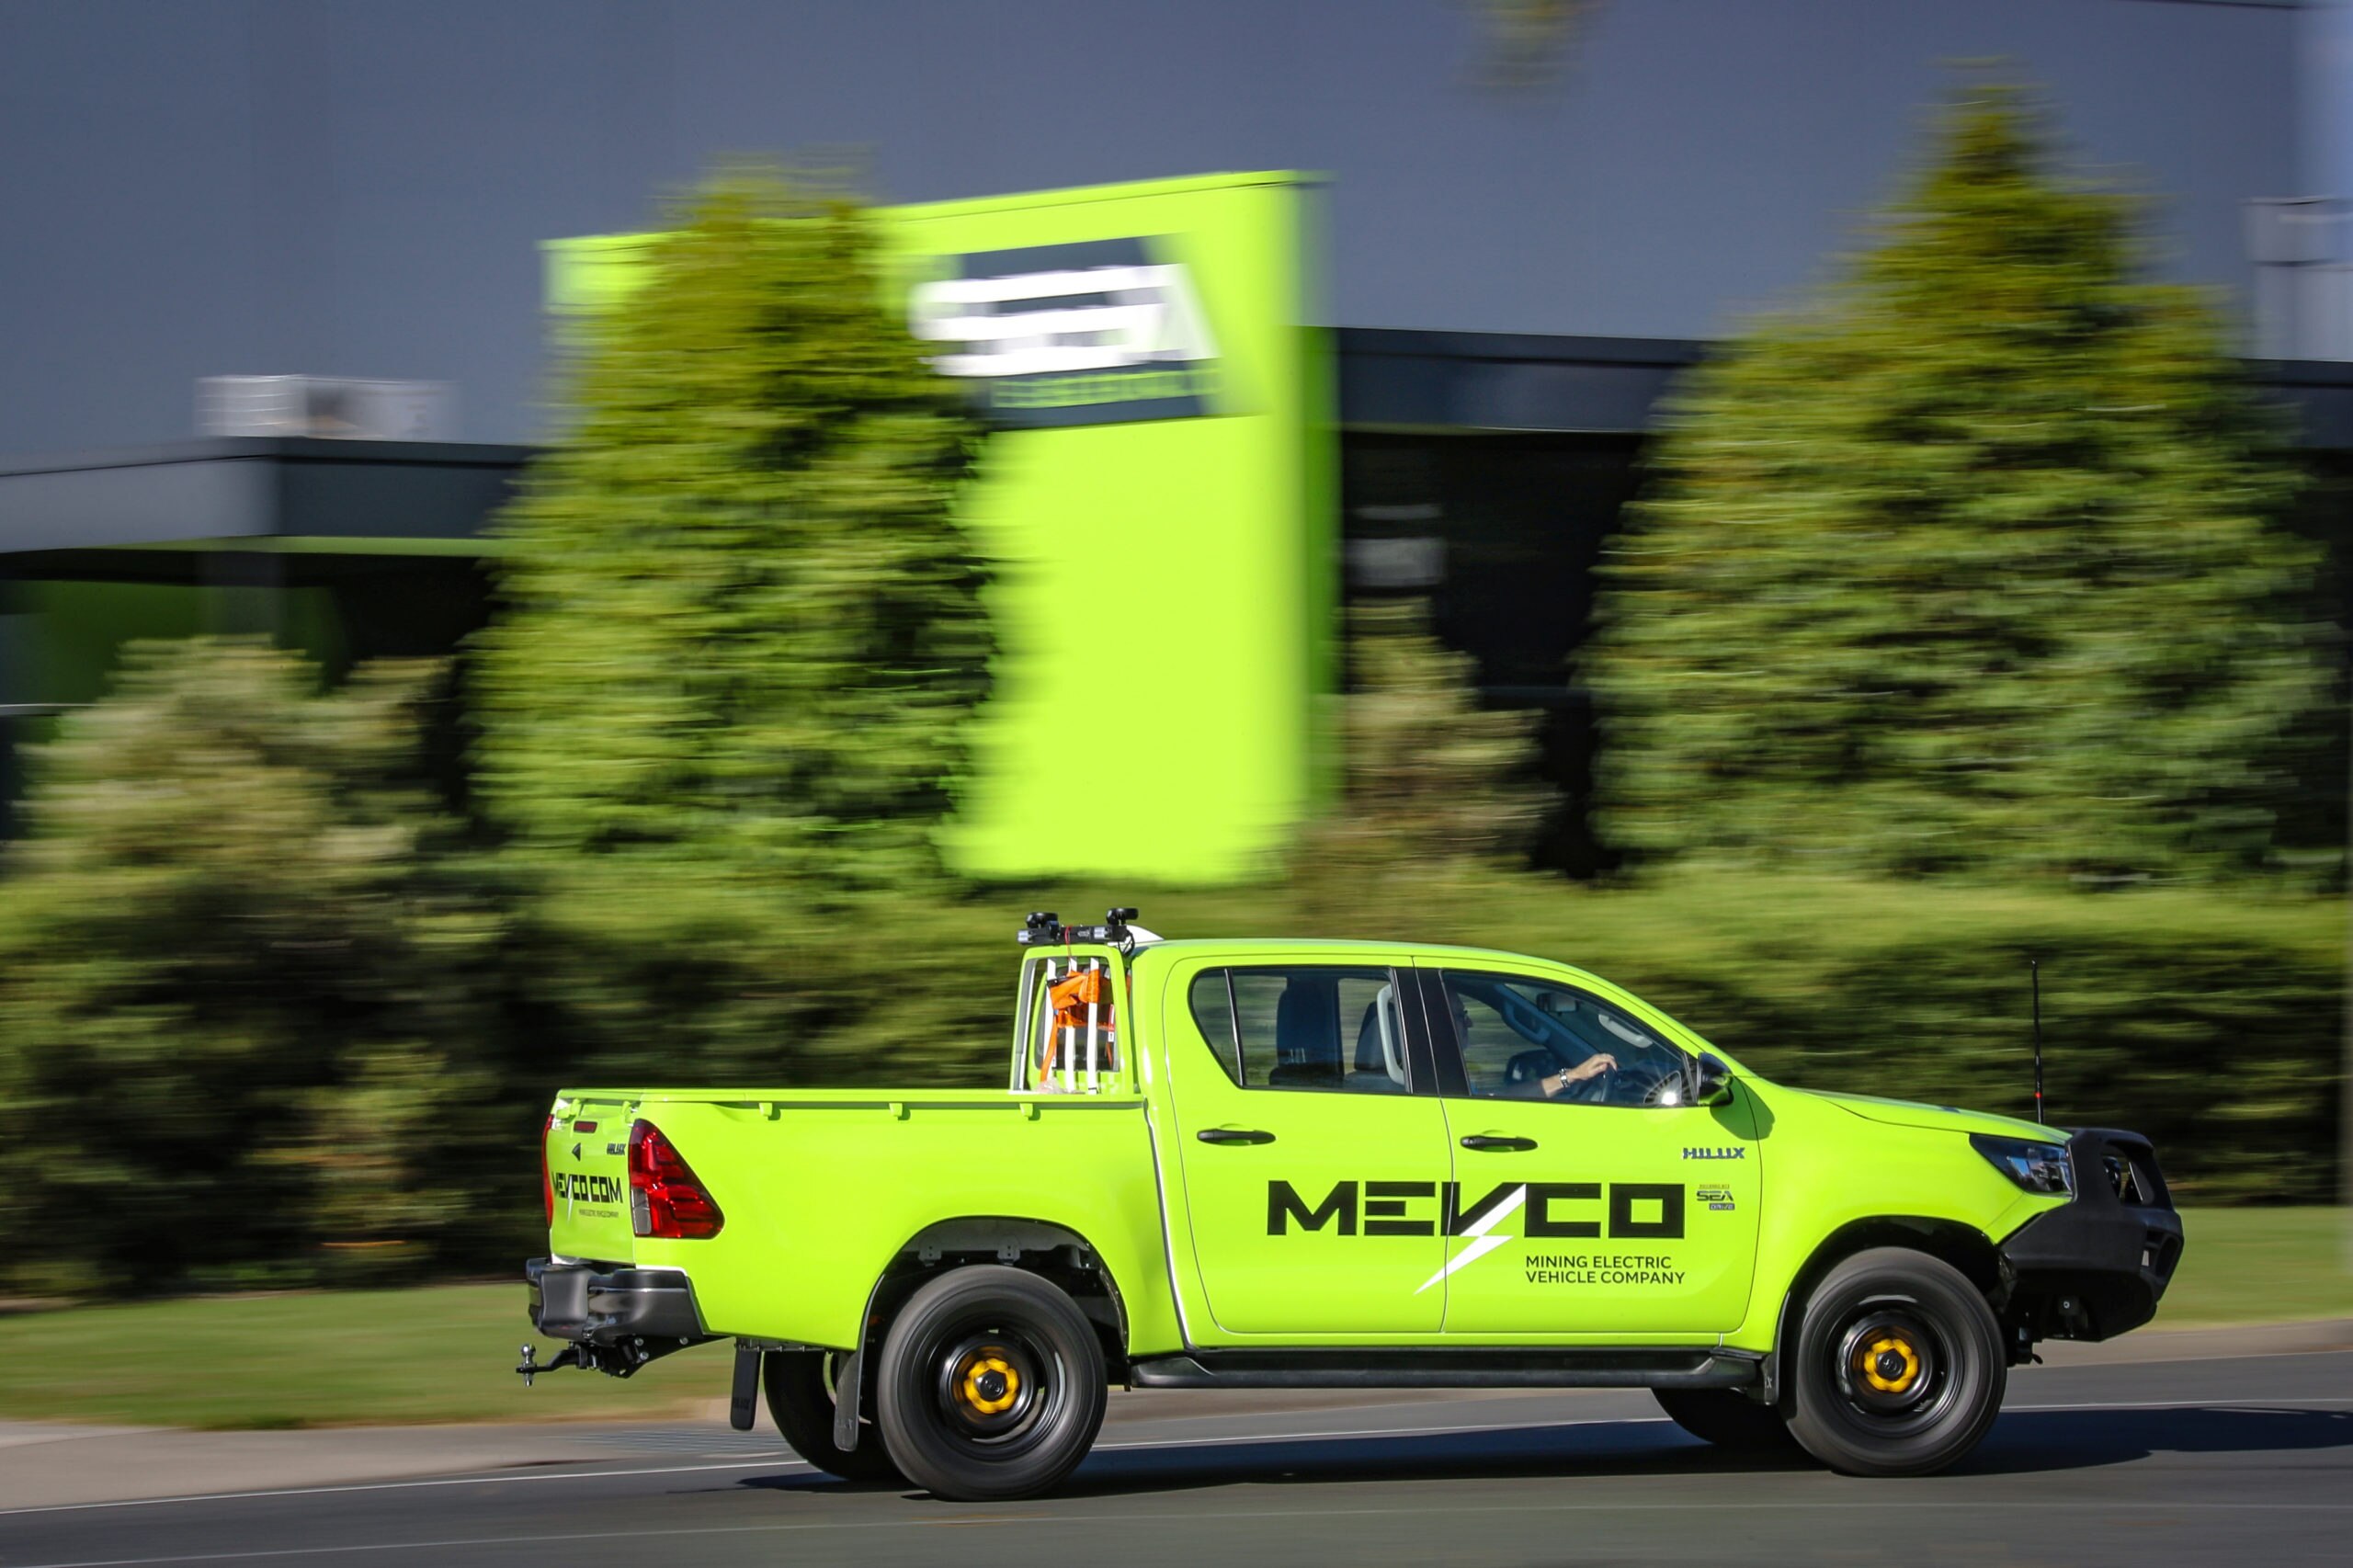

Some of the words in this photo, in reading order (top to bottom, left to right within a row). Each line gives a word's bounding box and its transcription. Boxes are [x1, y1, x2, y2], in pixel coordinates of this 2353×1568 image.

[1682, 1147, 1745, 1159] HILUX
[1697, 1190, 1733, 1201] SEA
[1267, 1179, 1686, 1239] MEVCO
[1526, 1256, 1587, 1268] MINING
[1593, 1256, 1672, 1268] ELECTRIC
[1526, 1270, 1597, 1283] VEHICLE
[1600, 1271, 1686, 1284] COMPANY
